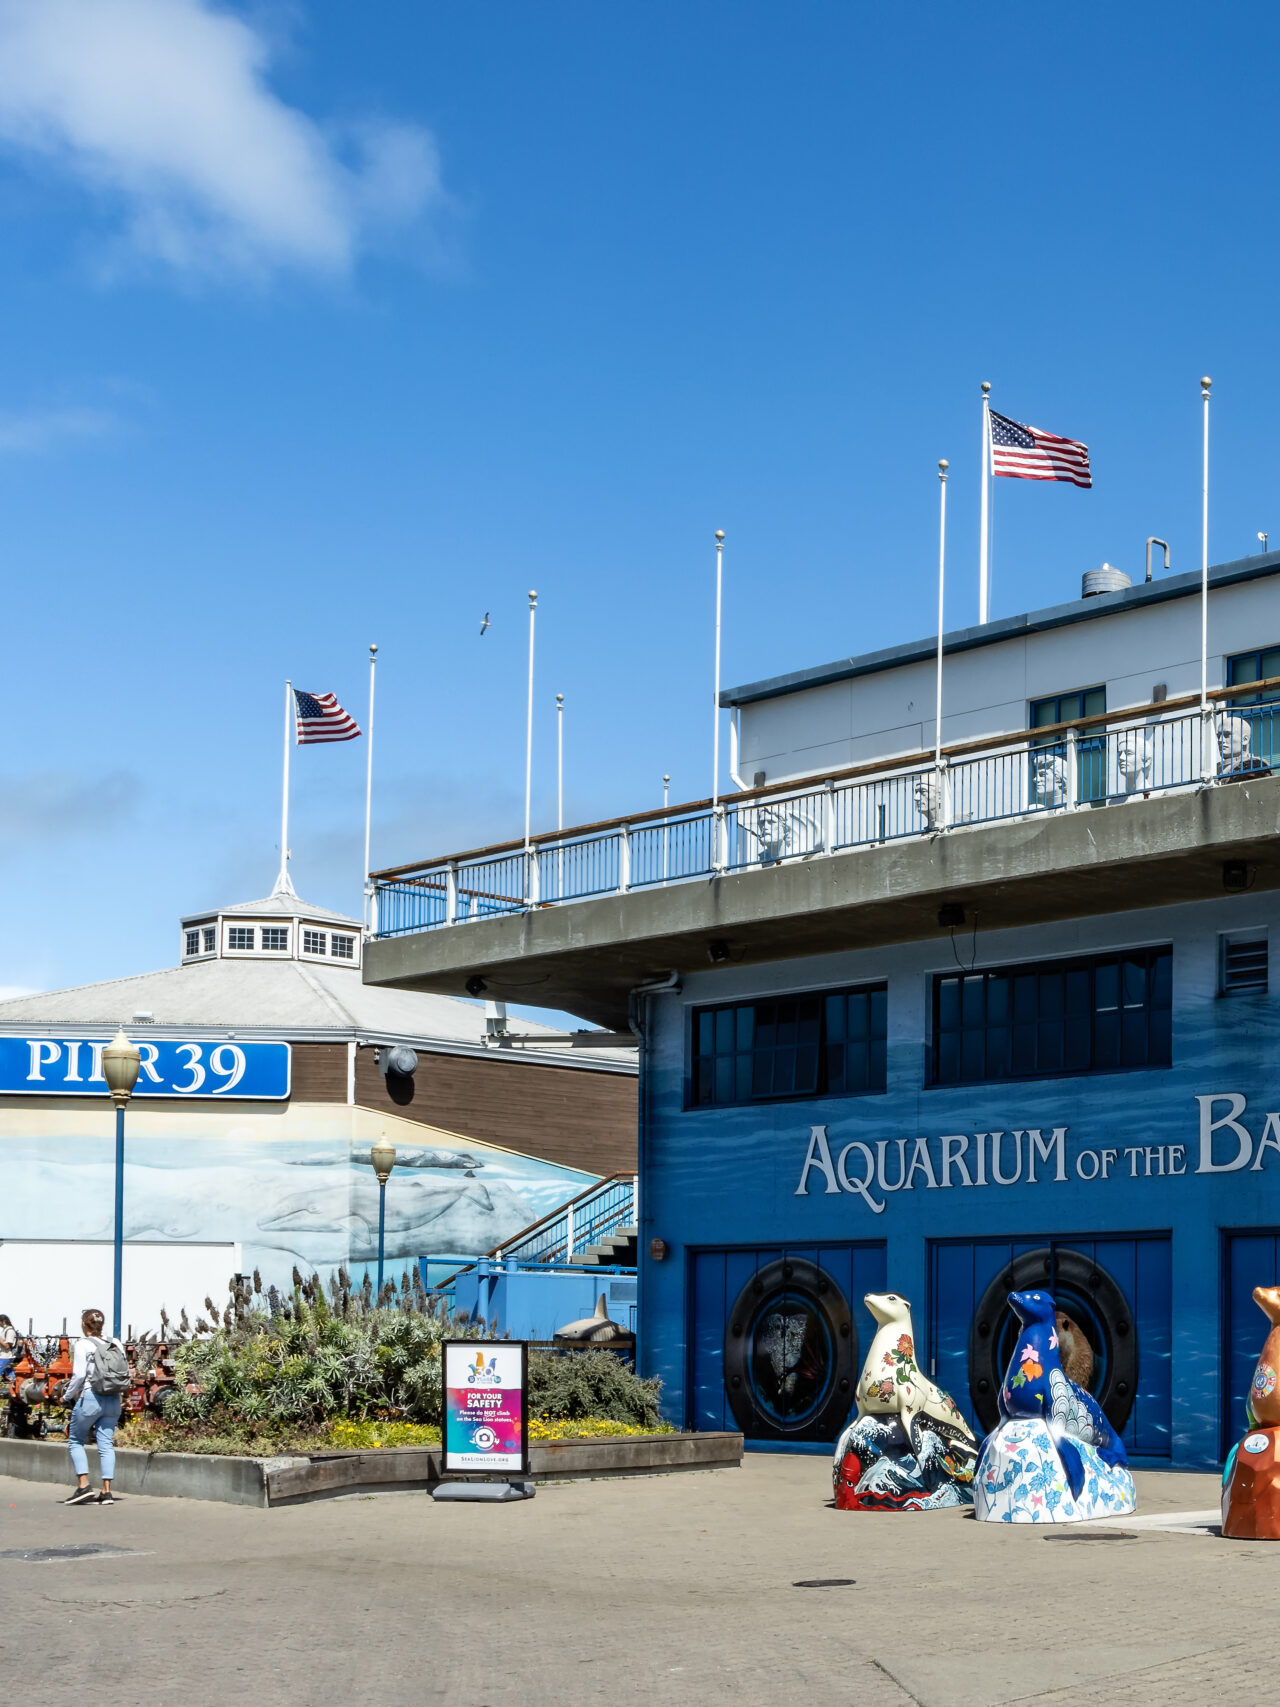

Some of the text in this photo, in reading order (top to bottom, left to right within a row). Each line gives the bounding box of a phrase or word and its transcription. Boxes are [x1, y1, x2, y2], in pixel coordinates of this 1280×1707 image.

[172, 1043, 247, 1094] 39
[793, 1124, 1069, 1214] AQUARIUM
[1075, 1148, 1117, 1180] OF
[1123, 1144, 1188, 1177] THE
[467, 1400, 503, 1408] SAFETY
